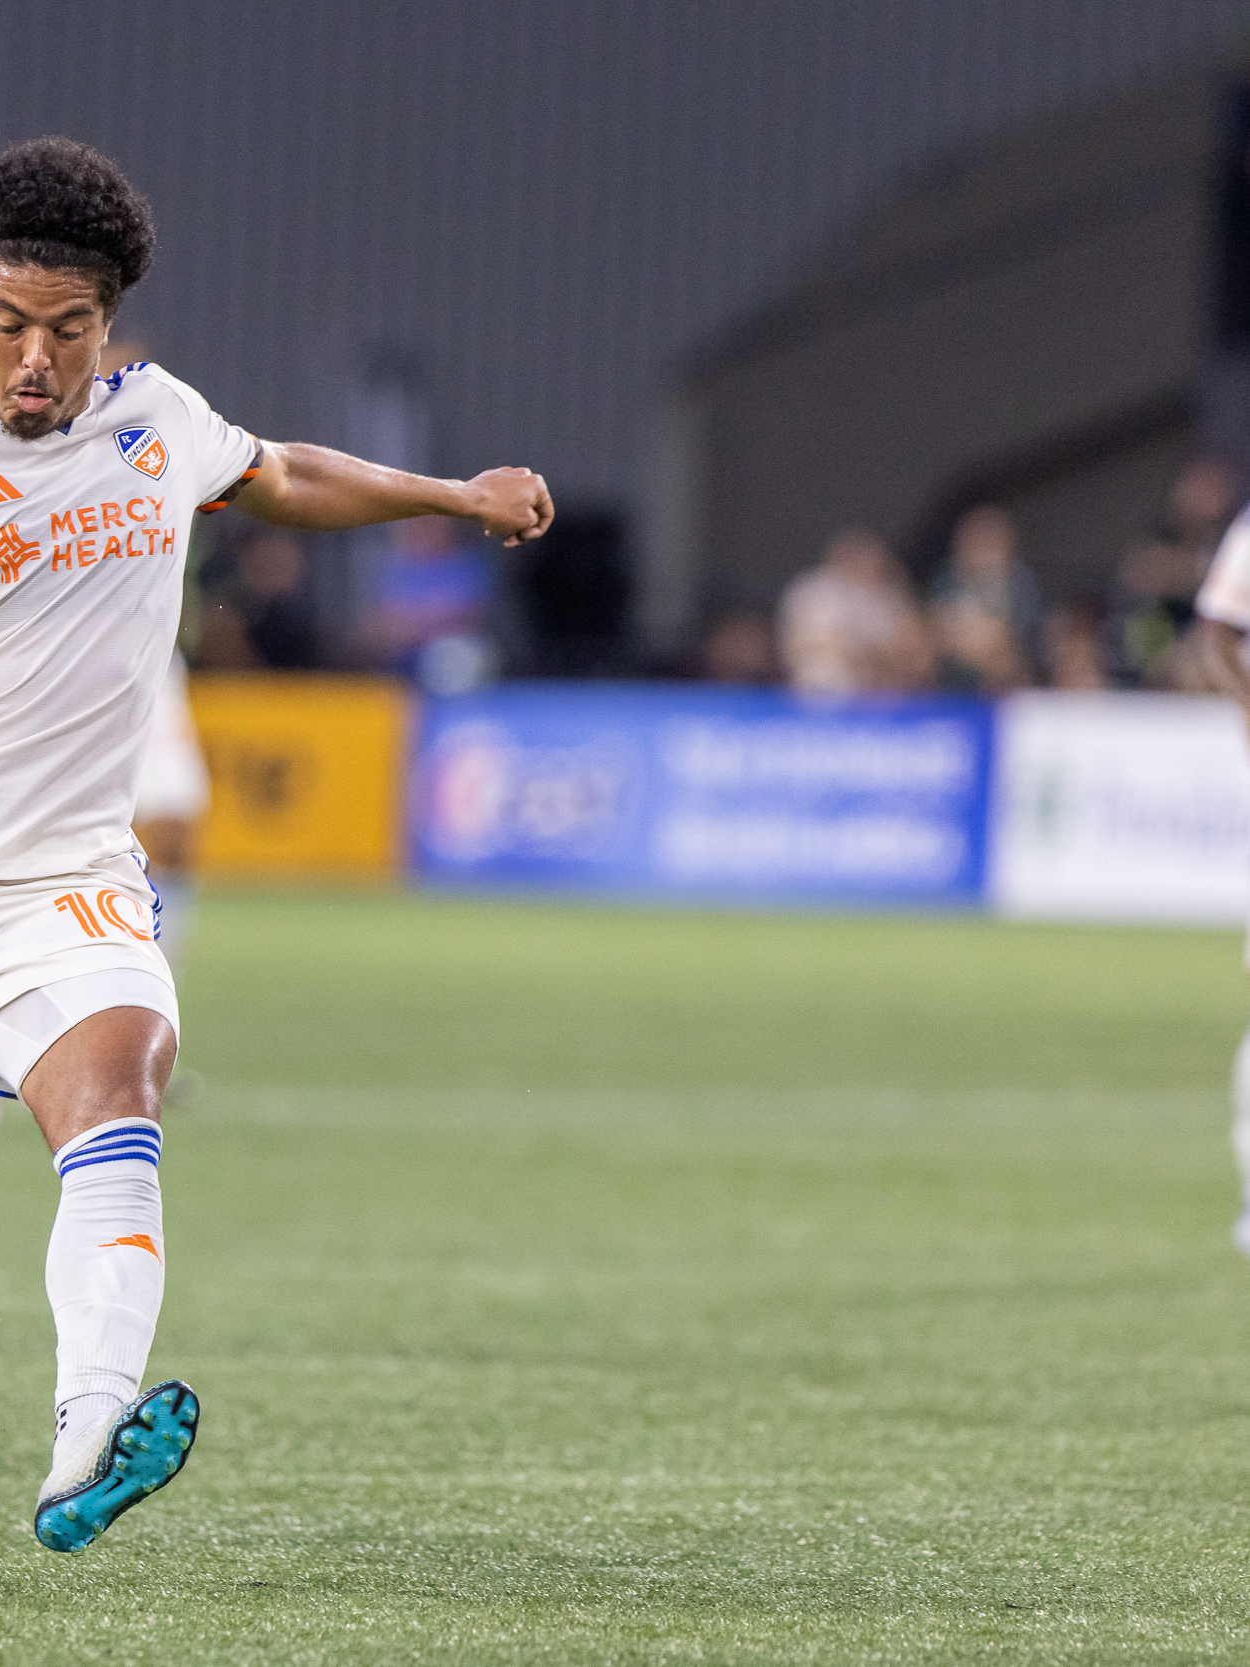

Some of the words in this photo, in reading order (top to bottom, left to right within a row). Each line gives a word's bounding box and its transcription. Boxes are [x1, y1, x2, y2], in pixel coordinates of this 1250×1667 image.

[127, 430, 156, 463] CINCINNATI
[50, 495, 165, 540] MERCY
[51, 527, 175, 572] HEALTH
[53, 889, 154, 942] 10
